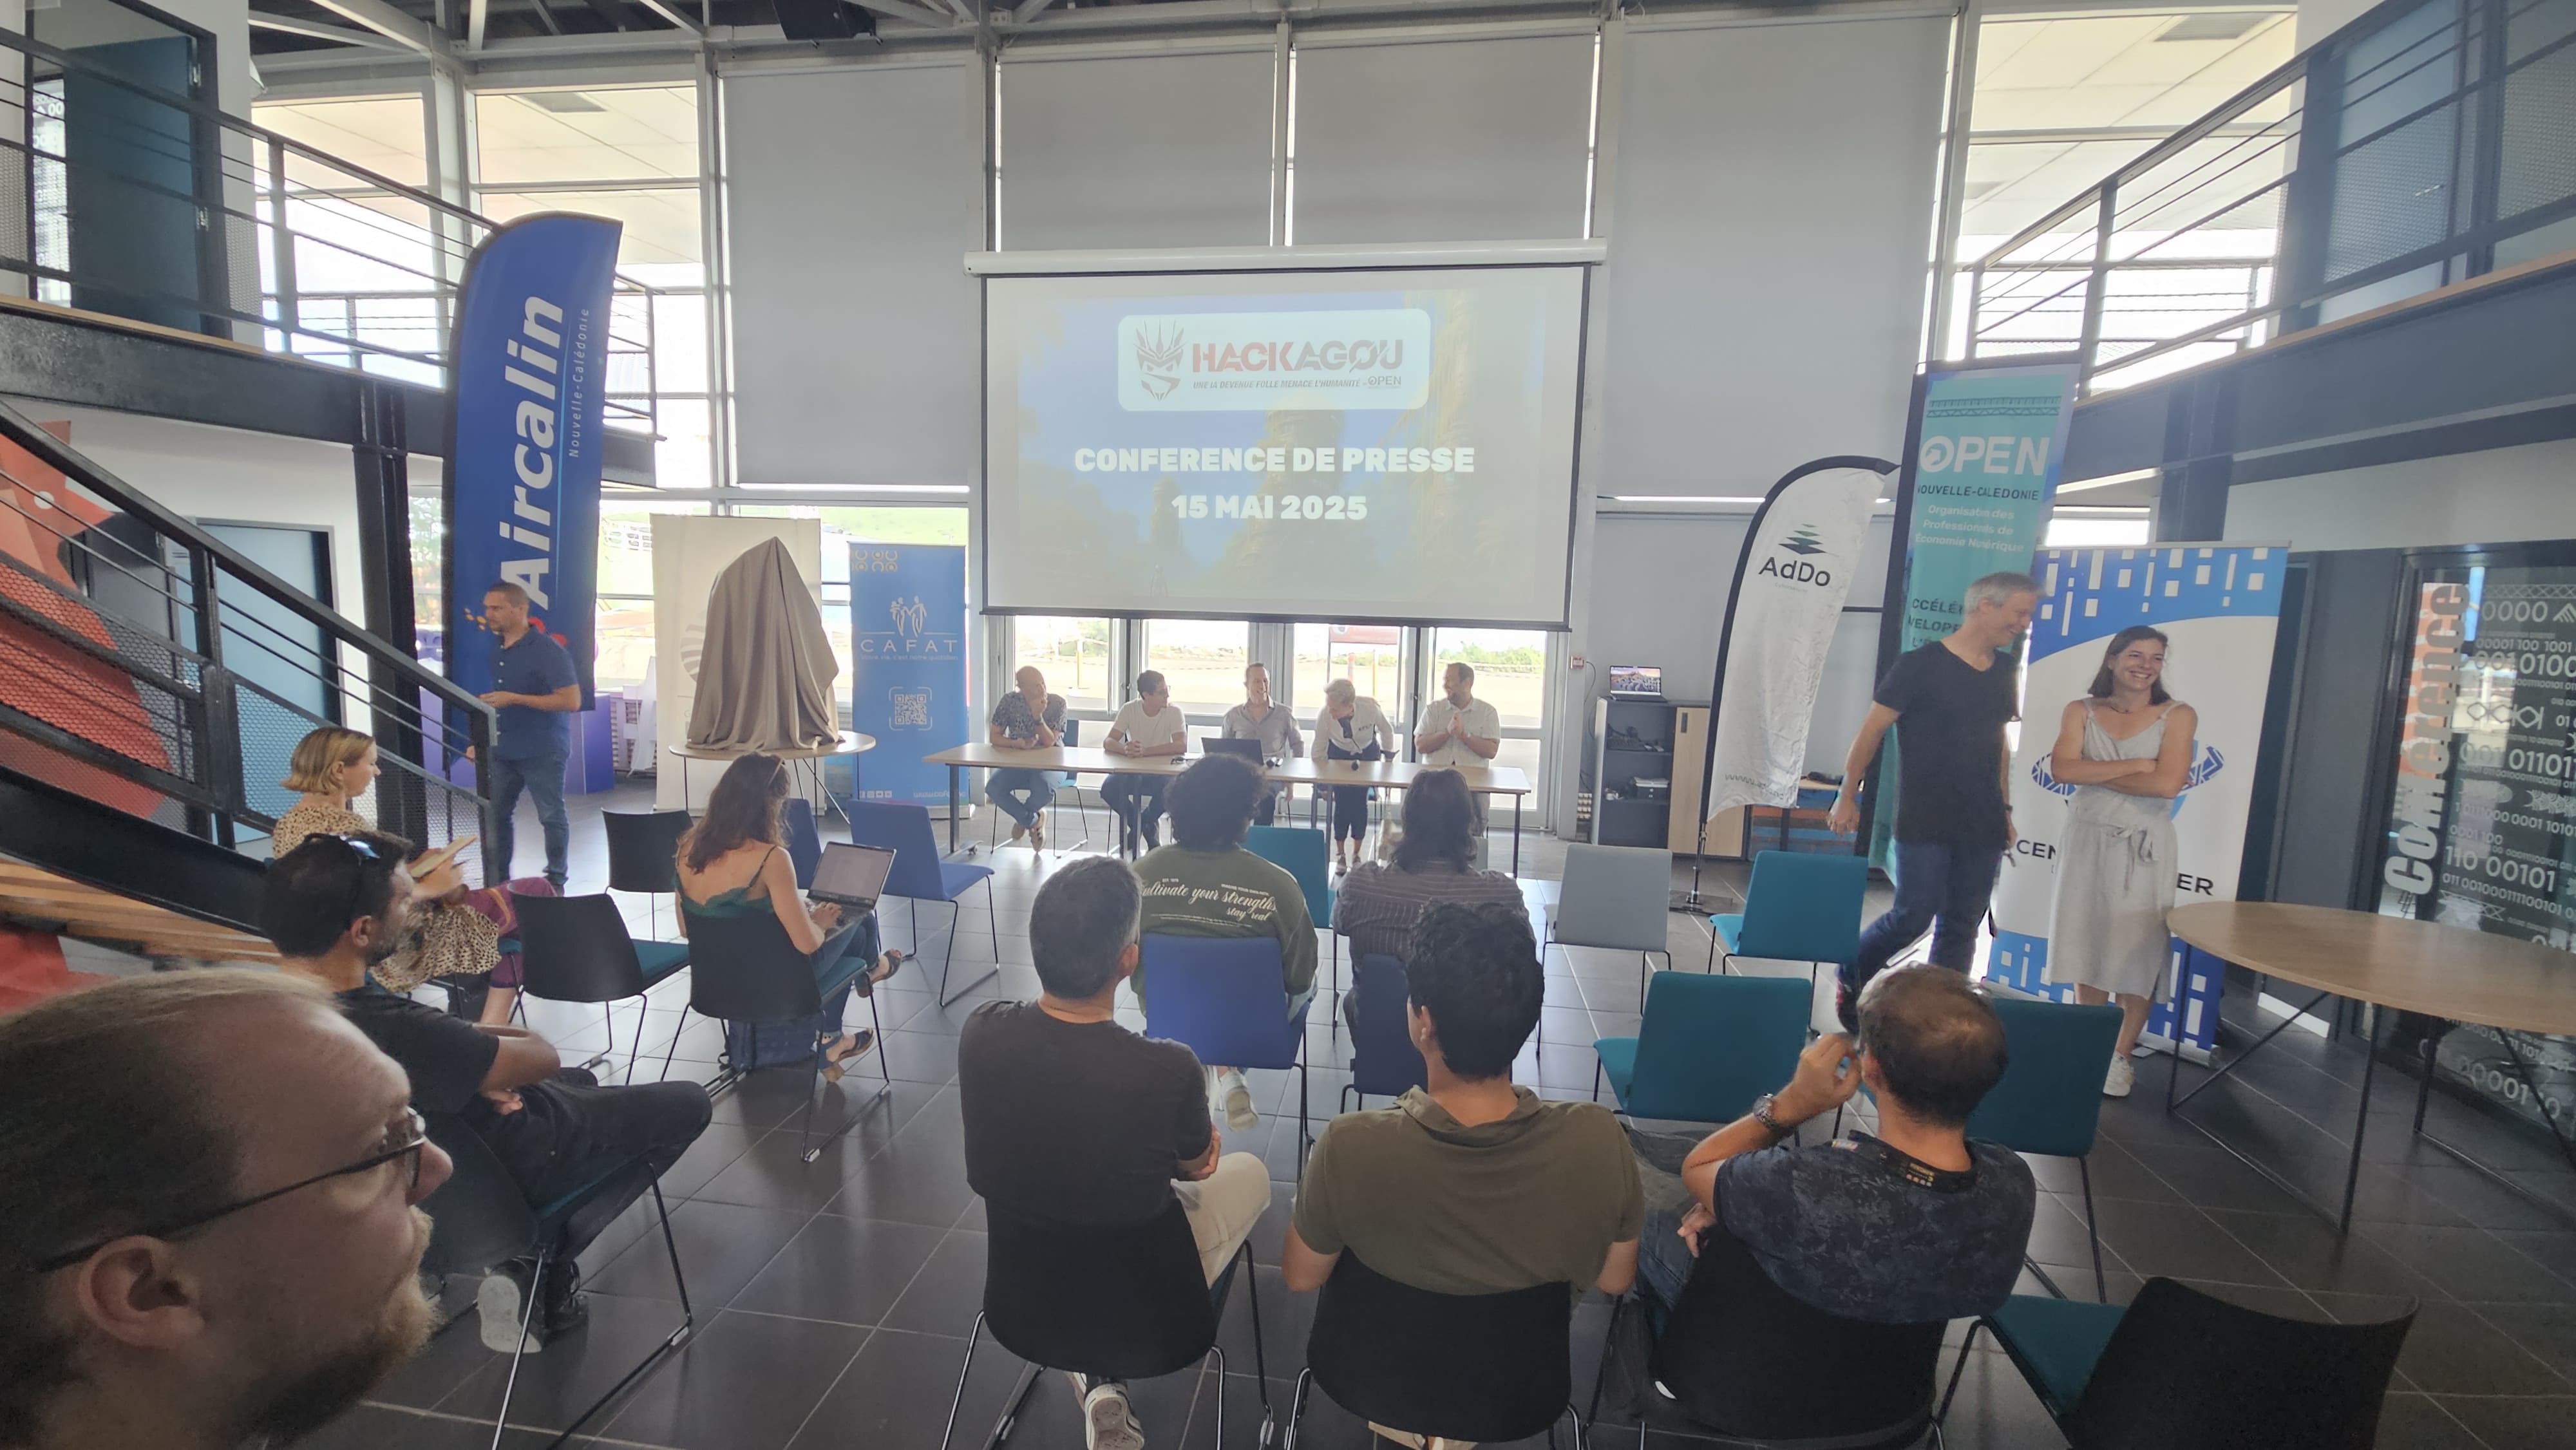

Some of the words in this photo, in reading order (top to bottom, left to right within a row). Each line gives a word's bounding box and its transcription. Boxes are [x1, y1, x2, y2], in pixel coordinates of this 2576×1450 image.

[569, 308, 589, 458] Nouvelle-Calédonie
[1193, 381, 1209, 390] UNE
[1209, 381, 1218, 389] IA
[1220, 380, 1254, 389] DEVENUE
[1256, 380, 1278, 388] FOLLE
[1280, 379, 1314, 388] MENACE
[1367, 375, 1401, 386] OPEN
[500, 295, 563, 610] Aircalin
[1074, 447, 1287, 473] CONFERENCE
[1293, 447, 1336, 473] DE
[1343, 447, 1475, 473] PRESSE
[1919, 435, 2050, 476] OPEN
[1171, 494, 1209, 519] 15
[1215, 494, 1274, 519] MAI
[1280, 494, 1368, 520] 2025
[1758, 556, 1831, 587] AdDo
[860, 639, 958, 653] CAFAT
[2486, 856, 2555, 892] 00101
[1142, 880, 1189, 897] ultivate
[1188, 887, 1220, 905] your
[1226, 907, 1248, 921] stay
[1250, 910, 1273, 921] real
